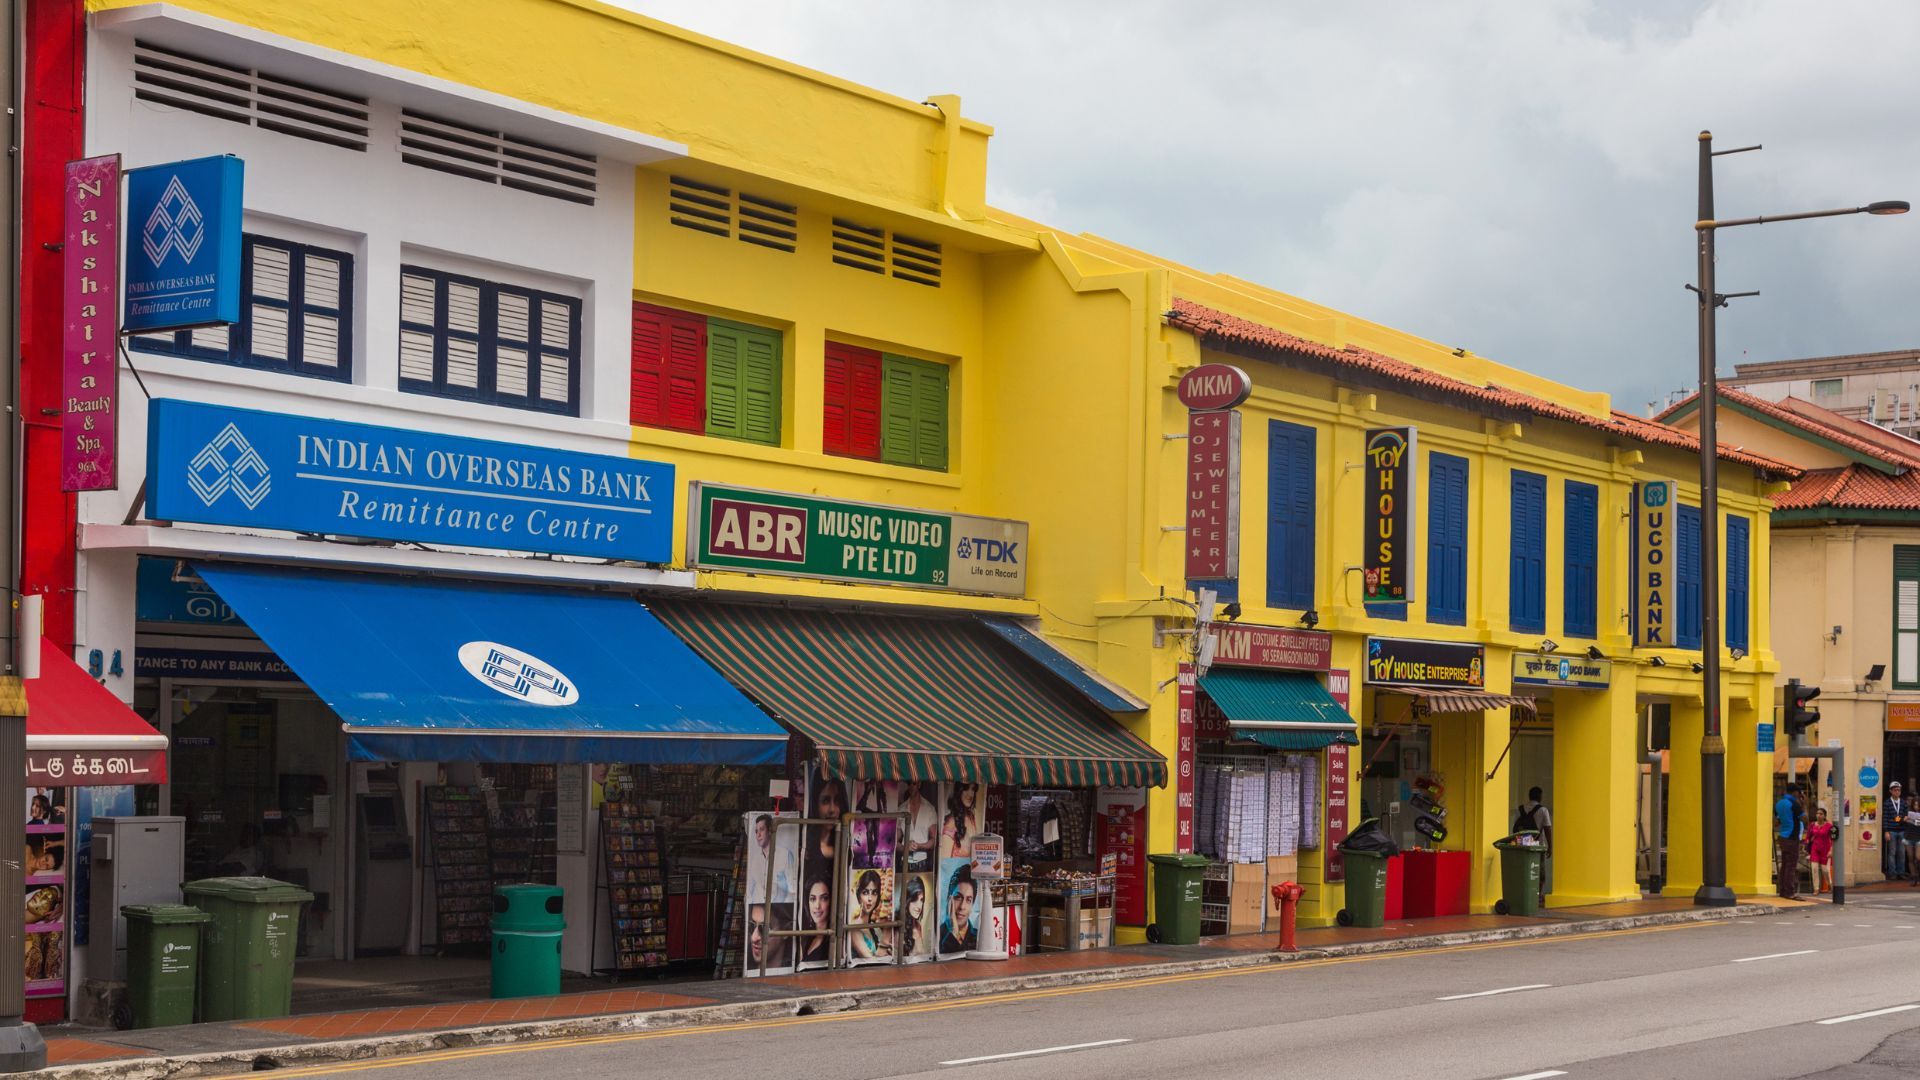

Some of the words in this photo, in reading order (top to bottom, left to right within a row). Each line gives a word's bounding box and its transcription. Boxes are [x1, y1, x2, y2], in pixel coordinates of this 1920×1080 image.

[78, 179, 102, 389] Nakshatra
[128, 281, 155, 293] INDIAN
[157, 277, 194, 290] OVERSEAS
[196, 273, 215, 286] BANK
[131, 301, 180, 316] Remittance
[182, 297, 211, 310] Centre
[1187, 374, 1232, 398] MKM
[68, 396, 110, 413] Beauty
[83, 415, 95, 431] &
[77, 434, 100, 454] Spa
[1367, 441, 1408, 469] TOY
[297, 435, 414, 475] INDIAN
[426, 450, 571, 493] OVERSEAS
[580, 468, 652, 502] BANK
[1191, 416, 1206, 537] COSTUME
[1209, 437, 1225, 573] JEWELLERY
[338, 490, 515, 534] Remittance
[527, 509, 619, 542] Centre
[714, 508, 802, 555] ABR
[818, 510, 882, 541] MUSIC
[888, 518, 943, 548] VIDEO
[1379, 470, 1394, 586] HOUSE
[1647, 512, 1663, 565] UCO
[842, 544, 878, 574] PTE
[883, 549, 917, 575] LTD
[972, 538, 1018, 564] TDK
[932, 570, 944, 583] 92
[971, 566, 983, 576] Life
[985, 569, 994, 577] on
[996, 568, 1018, 579] Record
[1647, 572, 1662, 643] BANK
[1252, 632, 1279, 648] COSTUME
[1279, 635, 1308, 651] JEWELLERY
[88, 649, 124, 678] 94
[181, 659, 197, 670] TO
[200, 660, 226, 671] ANY
[229, 661, 262, 672] BANK
[265, 662, 293, 673] ACC
[1270, 649, 1303, 664] SERANGOON
[1303, 653, 1319, 666] ROAD
[1370, 655, 1395, 680] TOY
[1394, 661, 1426, 680] HOUSE
[1427, 665, 1468, 681] ENTERPRISE
[1179, 672, 1195, 686] MKM
[1570, 665, 1583, 675] UCO
[1583, 666, 1601, 677] BANK
[1330, 676, 1348, 694] MKM
[26, 757, 64, 778] டகு
[1180, 760, 1190, 776] @
[1332, 760, 1344, 769] Sale
[1332, 775, 1345, 784] Price
